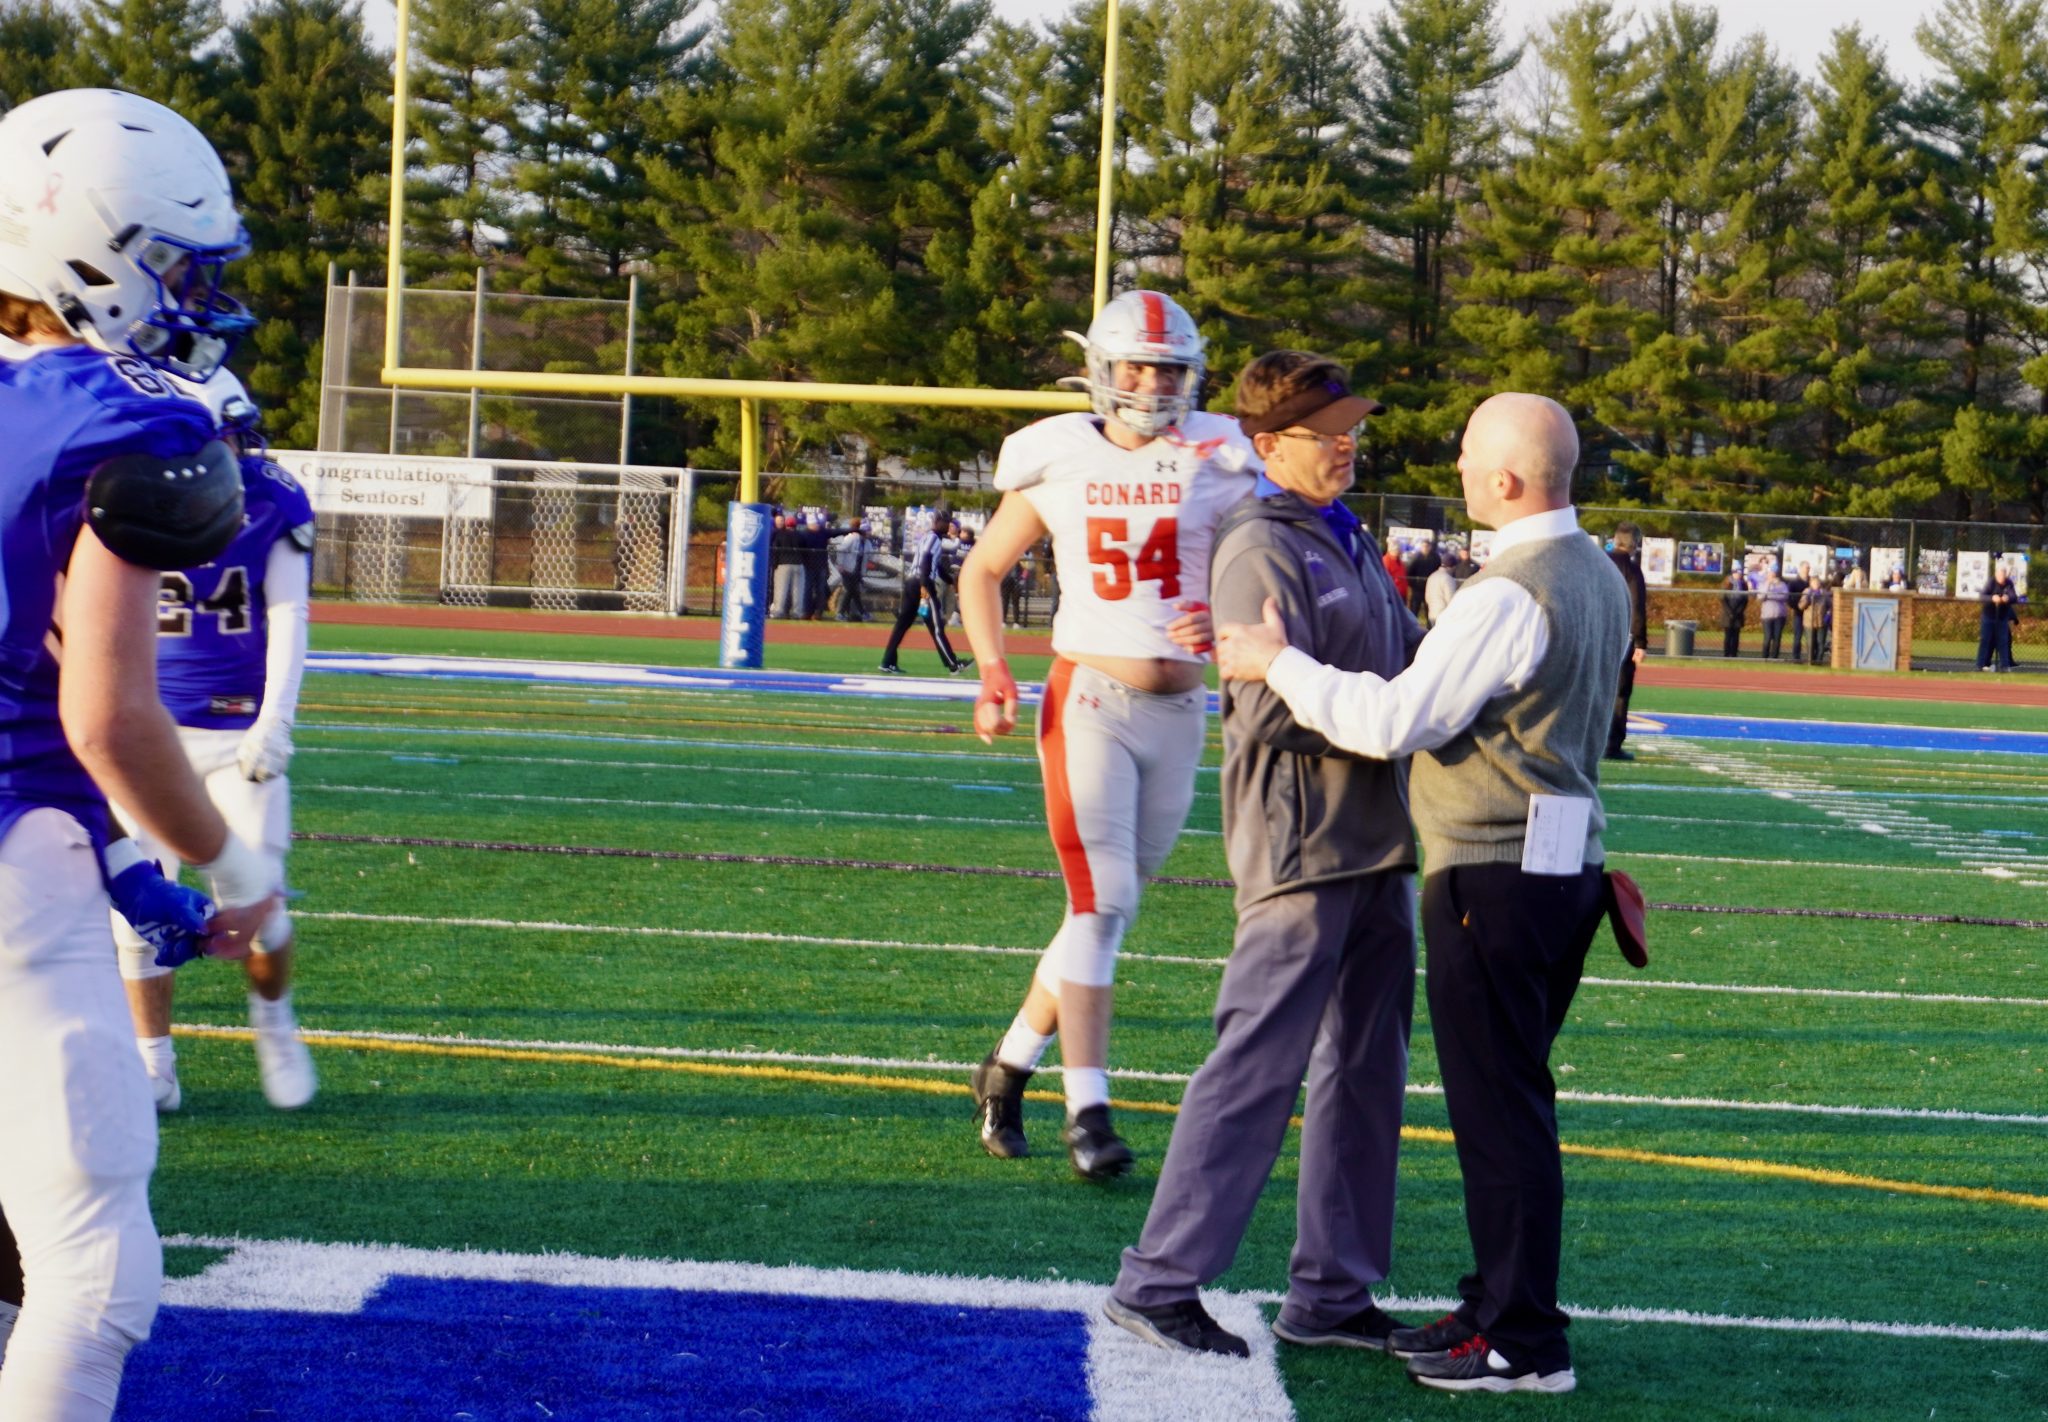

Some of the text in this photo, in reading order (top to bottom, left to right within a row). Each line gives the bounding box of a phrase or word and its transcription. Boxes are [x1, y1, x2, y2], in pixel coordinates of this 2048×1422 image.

[301, 462, 468, 483] Congratulations
[1086, 482, 1181, 505] CONARD
[341, 488, 425, 506] Seniors!
[1086, 516, 1181, 600] 54
[156, 566, 251, 637] 24
[728, 551, 755, 661] HALL
